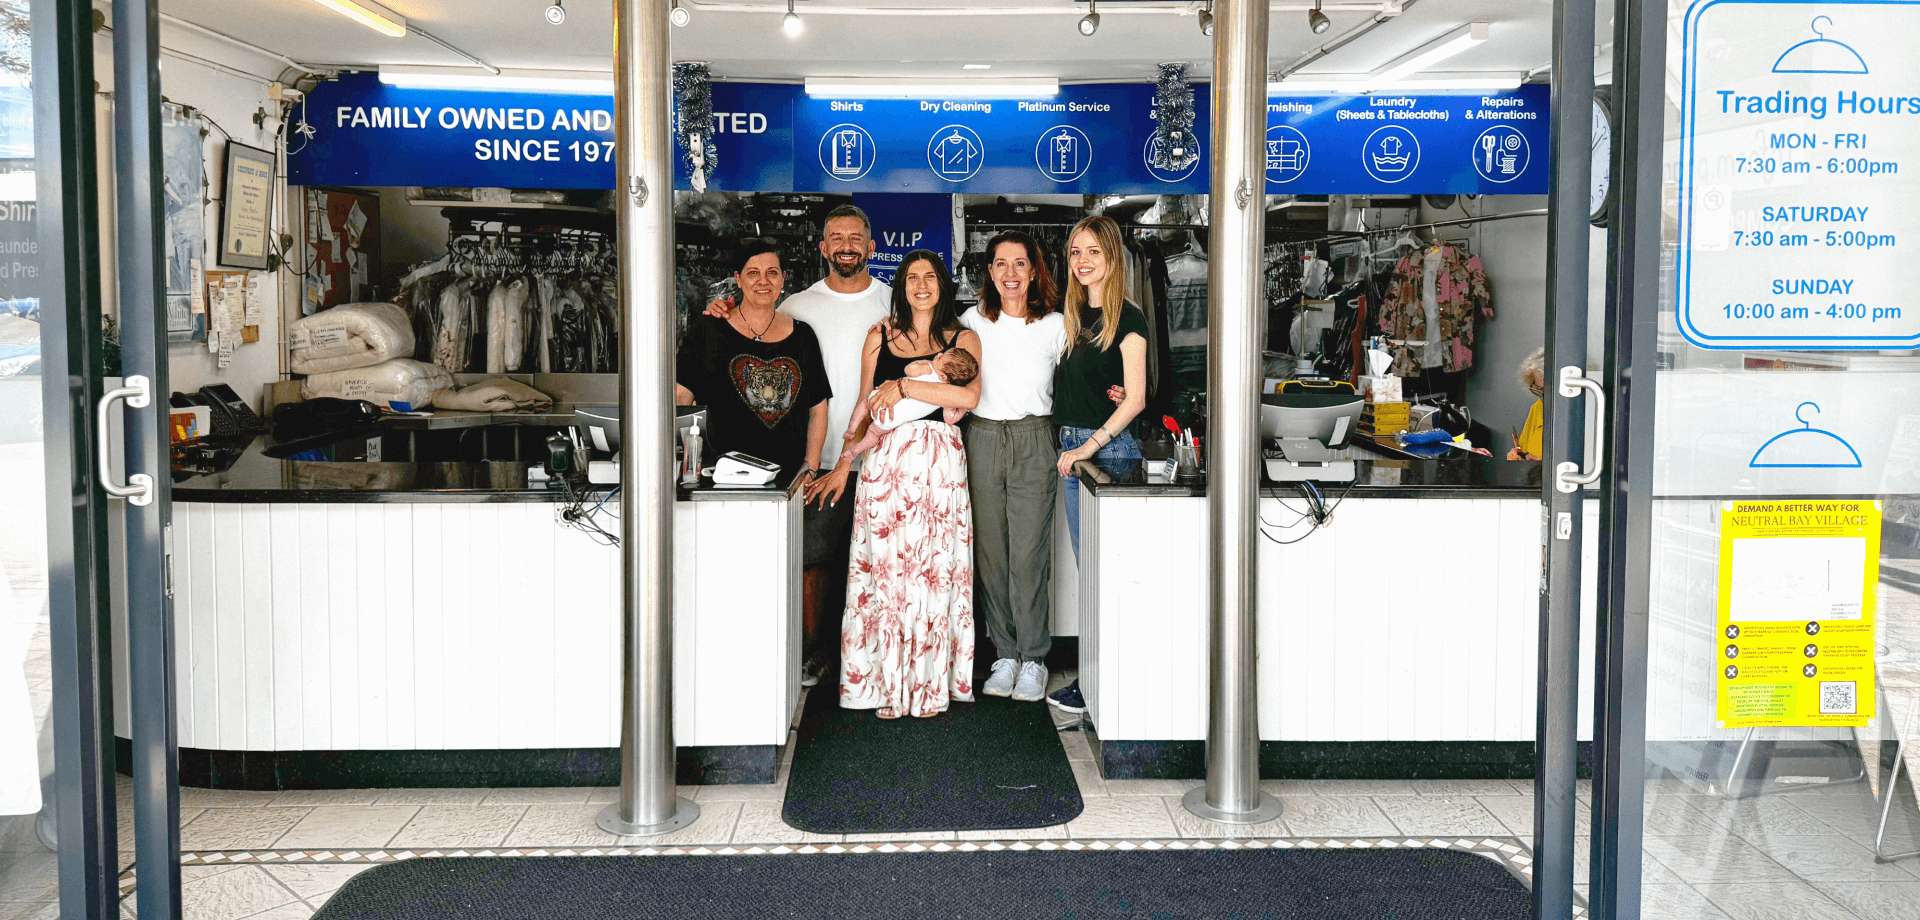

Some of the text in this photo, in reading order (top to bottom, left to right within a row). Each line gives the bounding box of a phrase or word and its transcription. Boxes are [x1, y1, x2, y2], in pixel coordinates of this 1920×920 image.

[830, 101, 864, 112] Shirts
[920, 101, 992, 114] Dry Cleaning
[1018, 101, 1111, 112] Platinum Service
[1267, 101, 1312, 114] rnishing
[1370, 97, 1417, 109] Laundry
[1481, 97, 1524, 108] Repairs
[1716, 90, 1920, 120] Trading Hours
[337, 106, 613, 132] FAMILY OWNED AND
[1336, 109, 1449, 121] (Sheets & Tablecloths)
[1464, 109, 1537, 120] & Alterations
[1770, 133, 1816, 149] MON
[1834, 133, 1867, 149] FRI
[474, 139, 616, 163] SINCE 197
[1735, 157, 1776, 174] 7:30
[1782, 161, 1811, 174] am
[1827, 157, 1899, 178] 6:00pm
[0, 200, 36, 222] Shir
[1762, 206, 1869, 222] SATURDAY
[0, 237, 38, 255] aunde
[883, 231, 923, 247] V.I.P
[1734, 231, 1774, 247] 7:30
[1779, 234, 1808, 247] am
[1825, 231, 1896, 250] 5:00pm
[870, 252, 903, 262] PRESS
[1771, 279, 1854, 295] SUNDAY
[1722, 303, 1775, 319] 10:00
[1780, 307, 1809, 319] am
[1826, 303, 1867, 319] 4:00
[1872, 307, 1902, 323] pm
[1737, 505, 1774, 513] DEMAND
[1784, 504, 1813, 512] BETTER
[1816, 504, 1839, 512] WAY
[1841, 504, 1860, 512] FOR
[1731, 515, 1868, 527] NEUTRAL BAY VILLAGE
